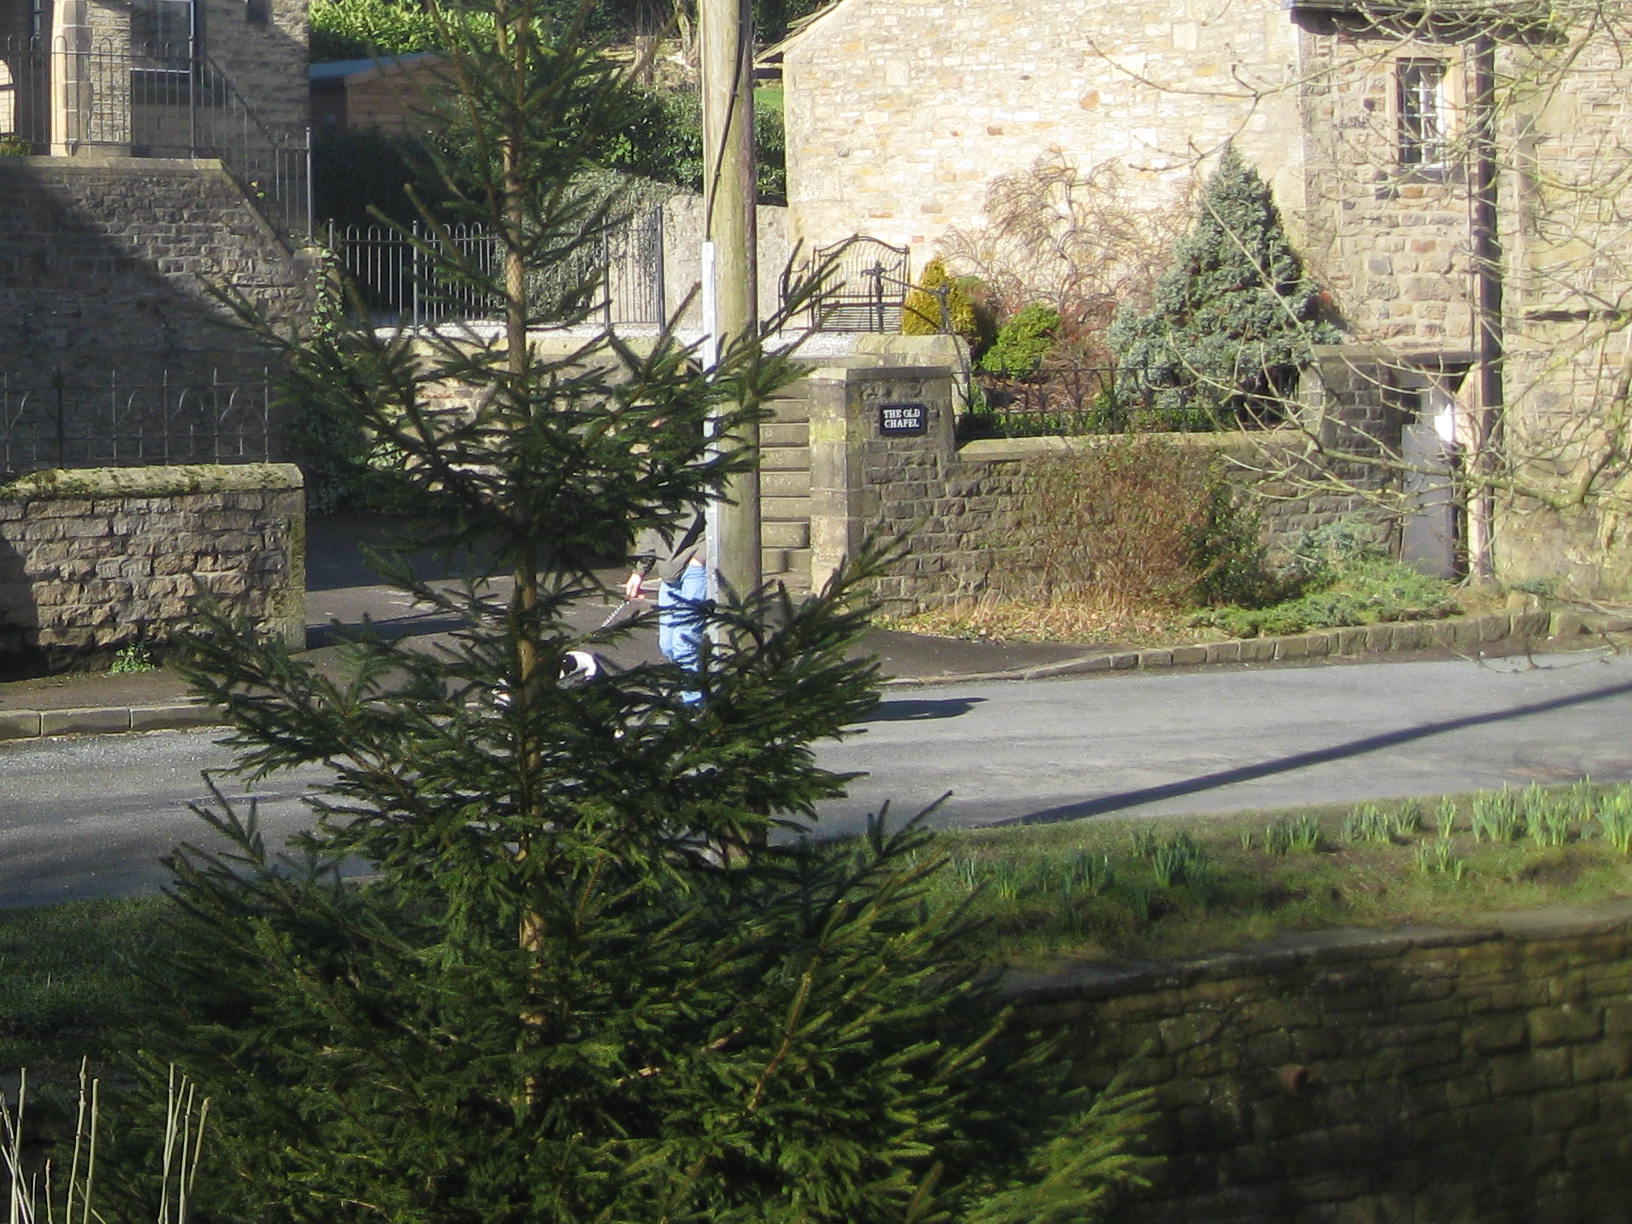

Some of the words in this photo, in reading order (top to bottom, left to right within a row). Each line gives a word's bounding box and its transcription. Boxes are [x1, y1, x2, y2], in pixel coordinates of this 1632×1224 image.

[883, 409, 901, 419] THE
[903, 408, 920, 418] OLD
[884, 418, 919, 428] CHAPEL
